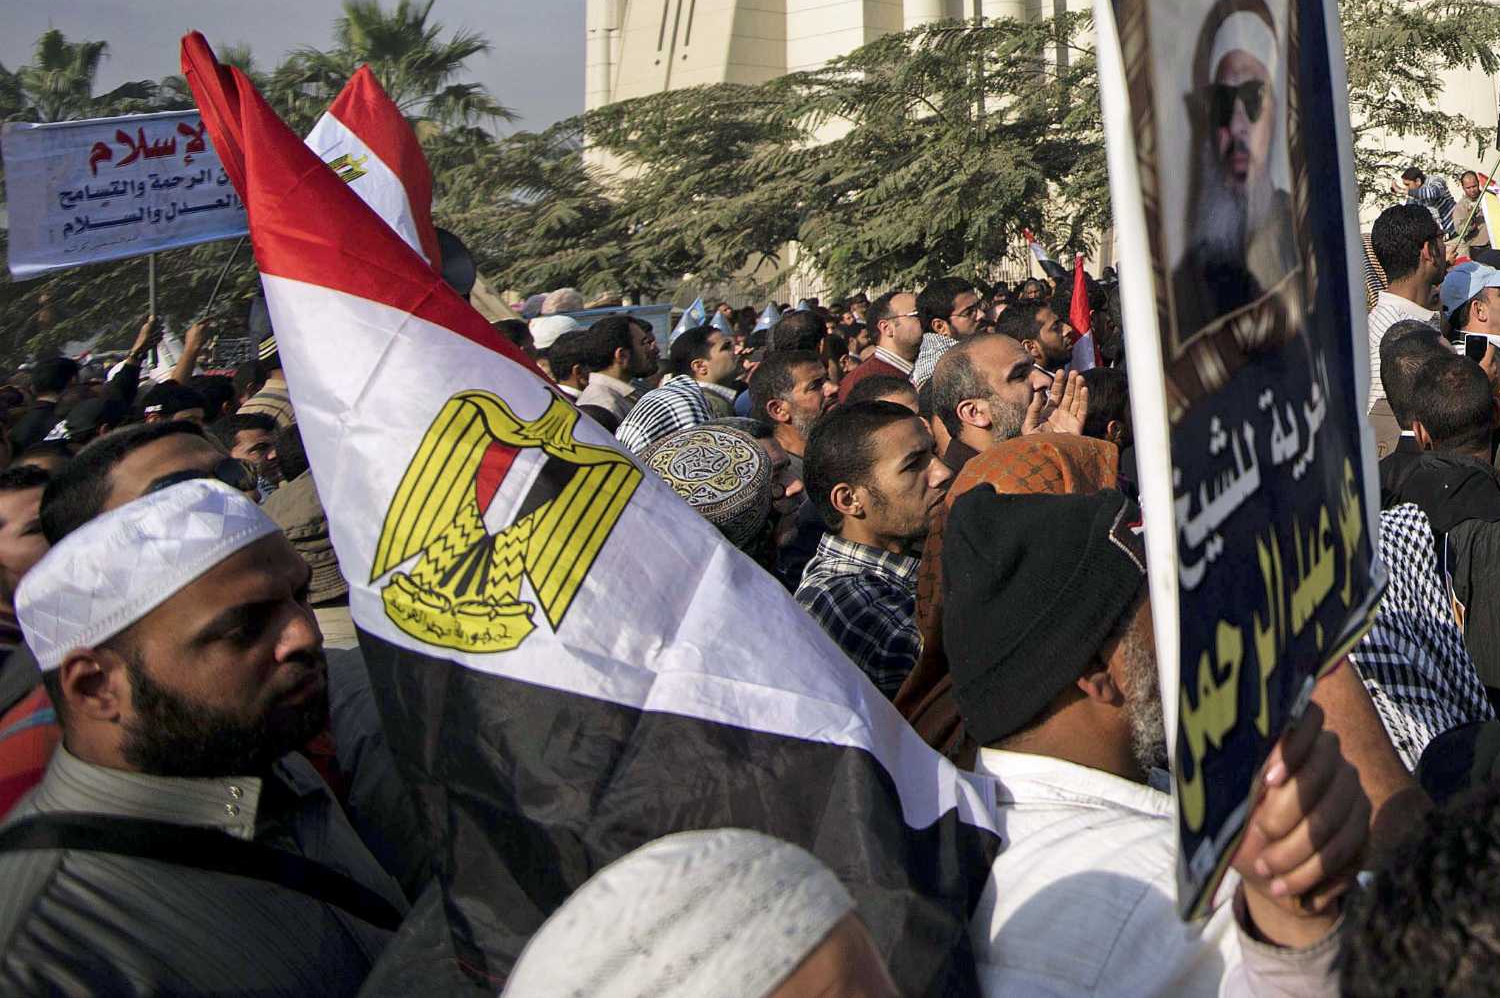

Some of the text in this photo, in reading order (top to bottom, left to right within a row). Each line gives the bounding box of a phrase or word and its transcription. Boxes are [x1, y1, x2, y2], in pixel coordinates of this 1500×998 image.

[89, 121, 206, 176] لإسلام
[63, 205, 161, 240] والسلام
[1173, 414, 1261, 591] للشيخ
[1290, 505, 1335, 652] عبد
